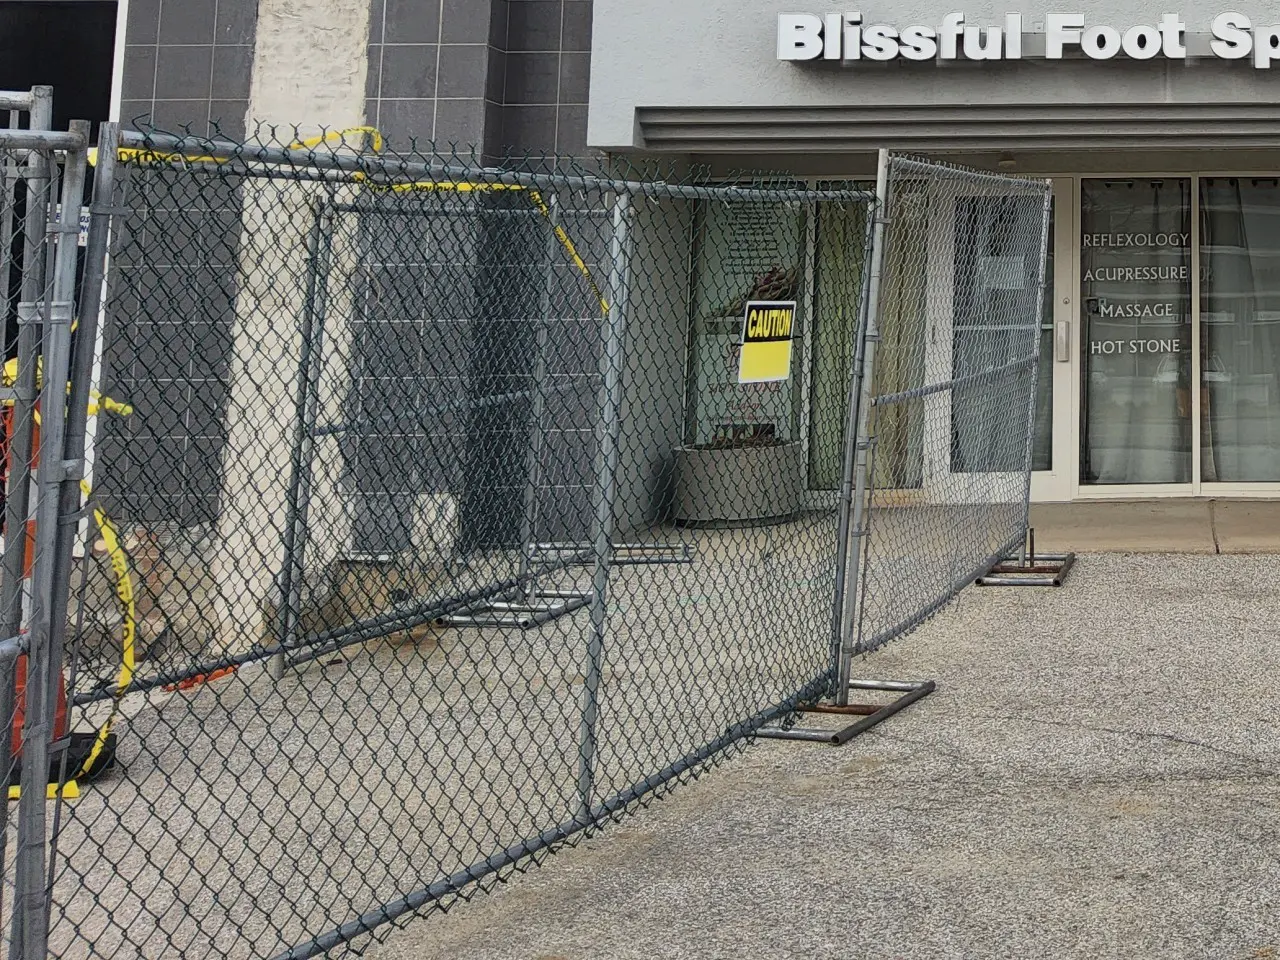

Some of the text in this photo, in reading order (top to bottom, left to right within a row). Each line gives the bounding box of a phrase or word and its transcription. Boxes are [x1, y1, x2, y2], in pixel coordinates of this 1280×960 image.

[777, 11, 1022, 61] Blissful
[1045, 12, 1186, 61] Foot
[1083, 232, 1189, 247] REFLEXOLOGY
[1083, 266, 1188, 282] ACUPRESSURE
[1100, 303, 1174, 318] MASSAGE
[747, 309, 792, 339] CAUTION
[1091, 339, 1180, 354] HOT STONE
